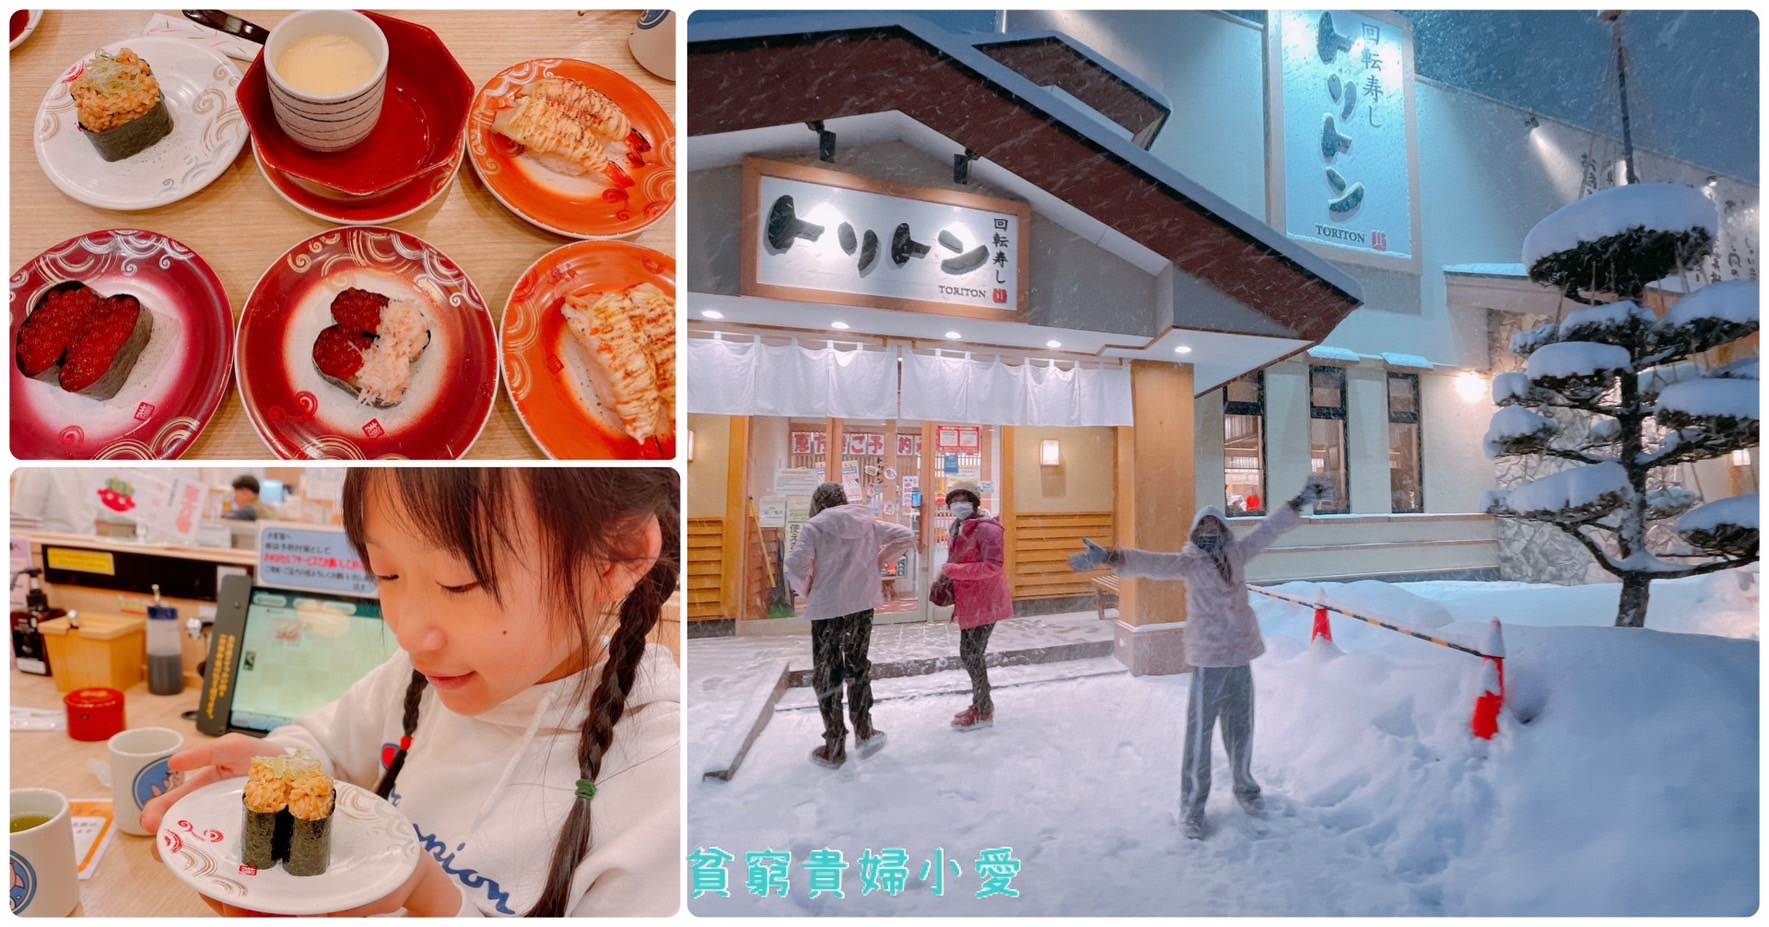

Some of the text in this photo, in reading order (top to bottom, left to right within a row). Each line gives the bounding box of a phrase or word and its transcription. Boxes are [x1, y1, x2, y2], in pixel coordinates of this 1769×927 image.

[1317, 11, 1365, 220] トリトン
[1361, 22, 1384, 128] 回転寿し
[767, 194, 990, 276] トリトン
[992, 218, 1009, 285] 回転寿し
[1315, 225, 1366, 243] TORITON
[938, 284, 986, 299] TORITON
[388, 782, 516, 915] pion
